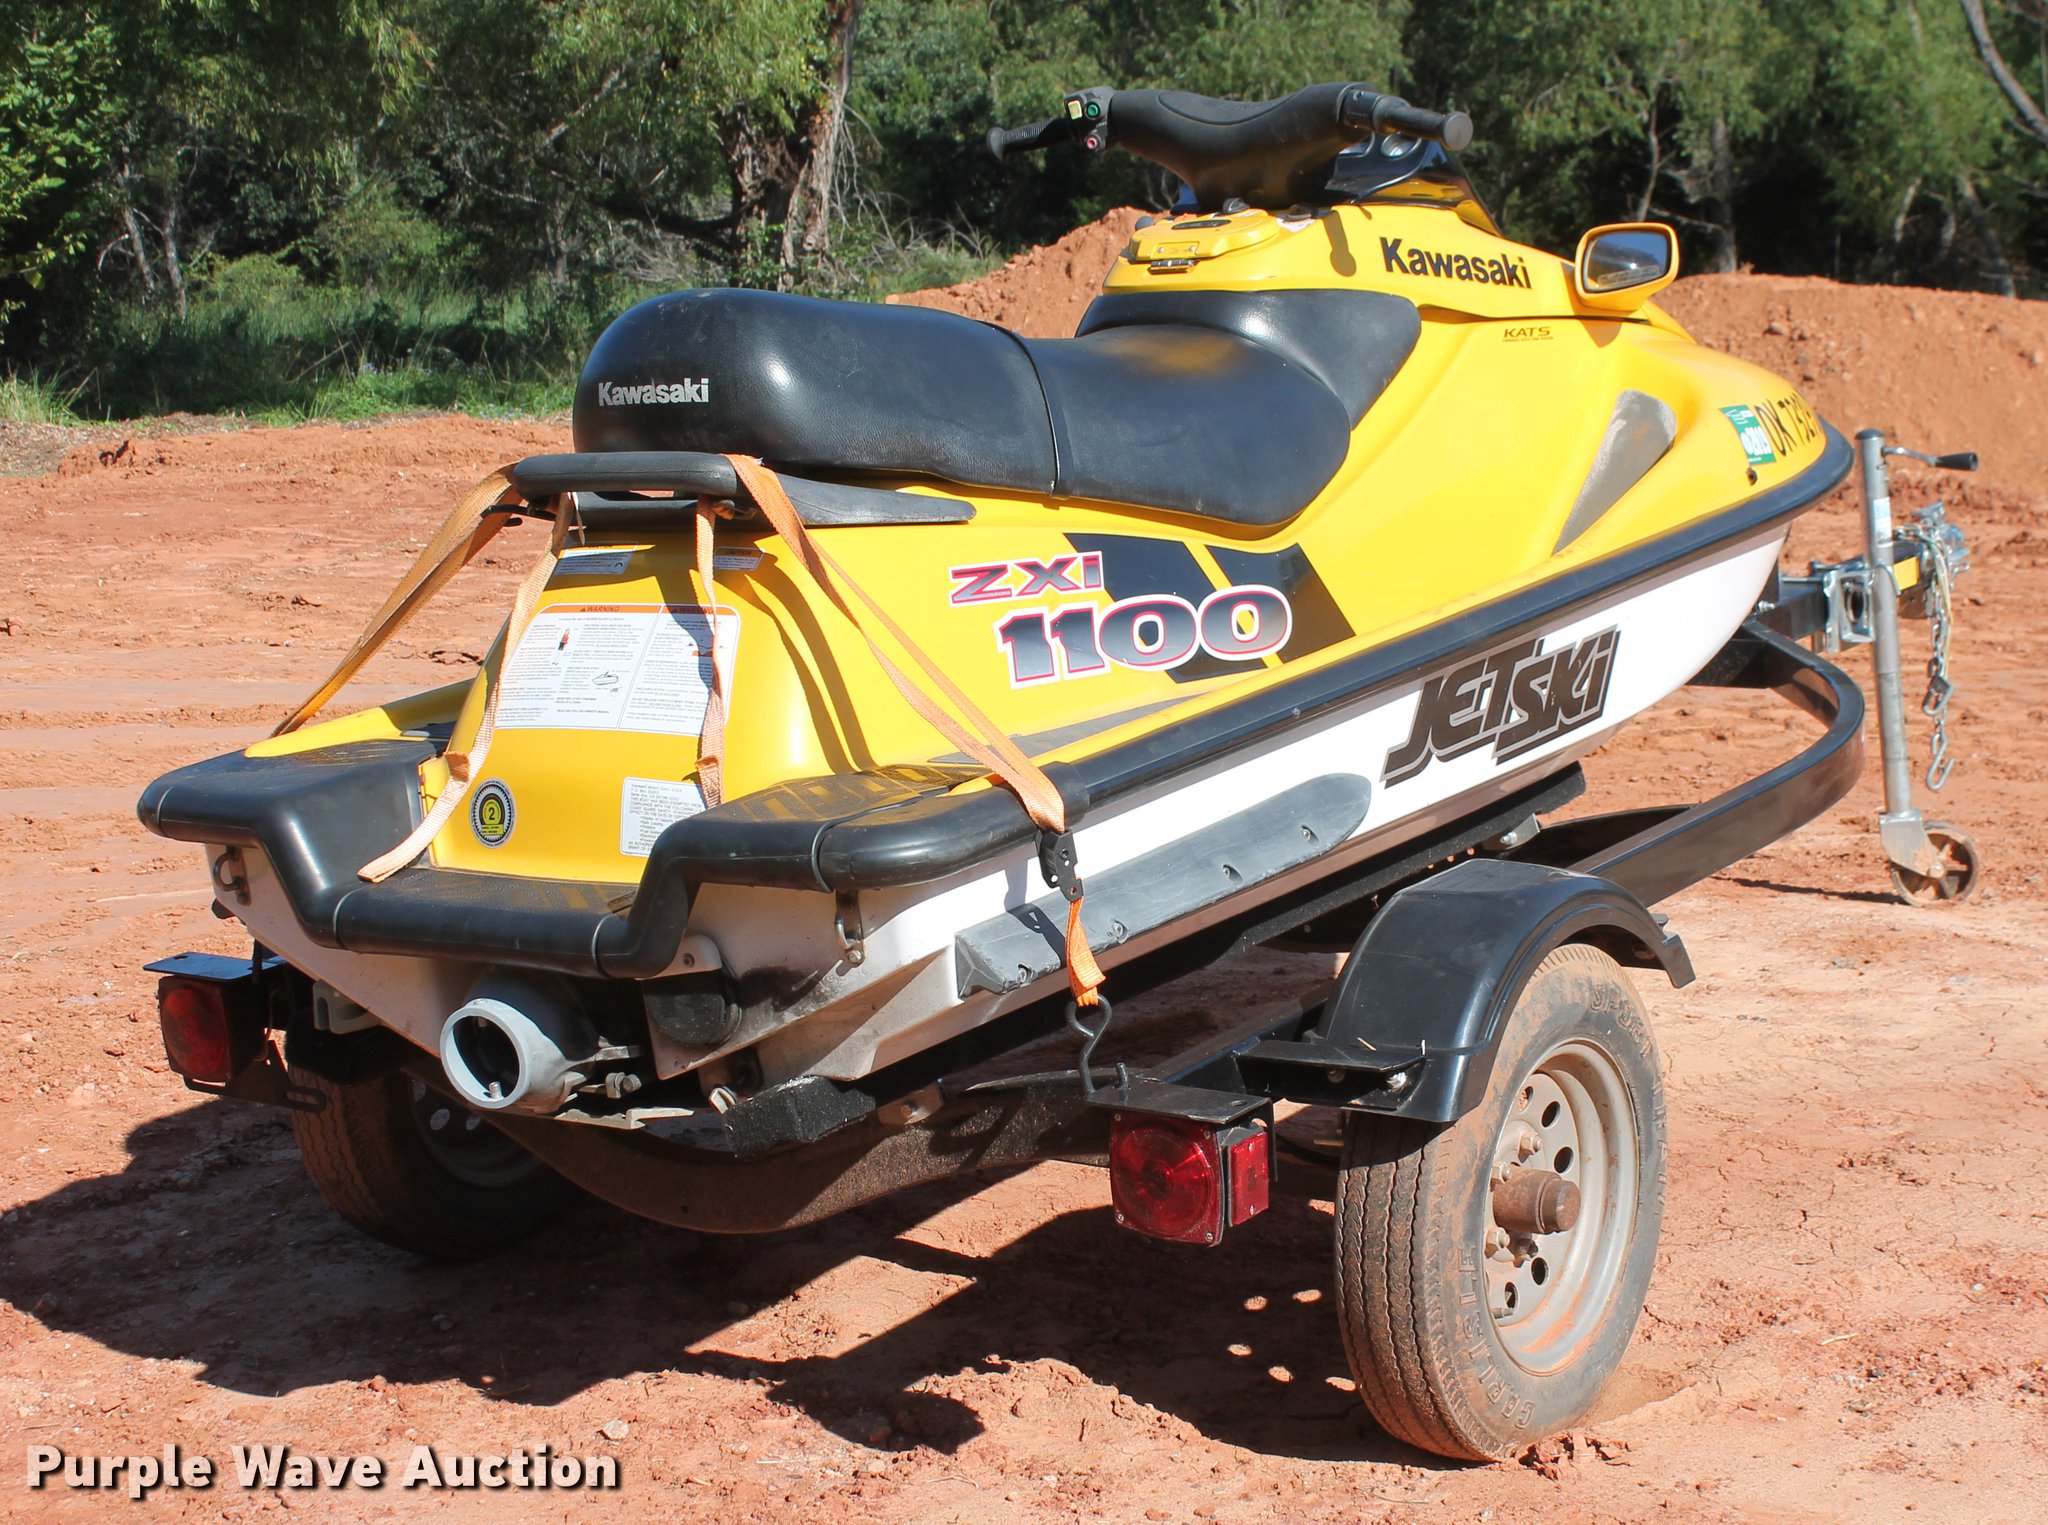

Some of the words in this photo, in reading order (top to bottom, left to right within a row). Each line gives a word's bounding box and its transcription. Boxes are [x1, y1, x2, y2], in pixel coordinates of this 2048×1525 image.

[1379, 237, 1532, 289] Kawasaki
[1504, 326, 1551, 338] KATS
[597, 378, 710, 406] Kawasaki
[587, 605, 620, 613] WARNING
[994, 585, 1292, 688] 1100
[488, 807, 495, 821] 2
[1458, 1245, 1536, 1430] CARLISLE
